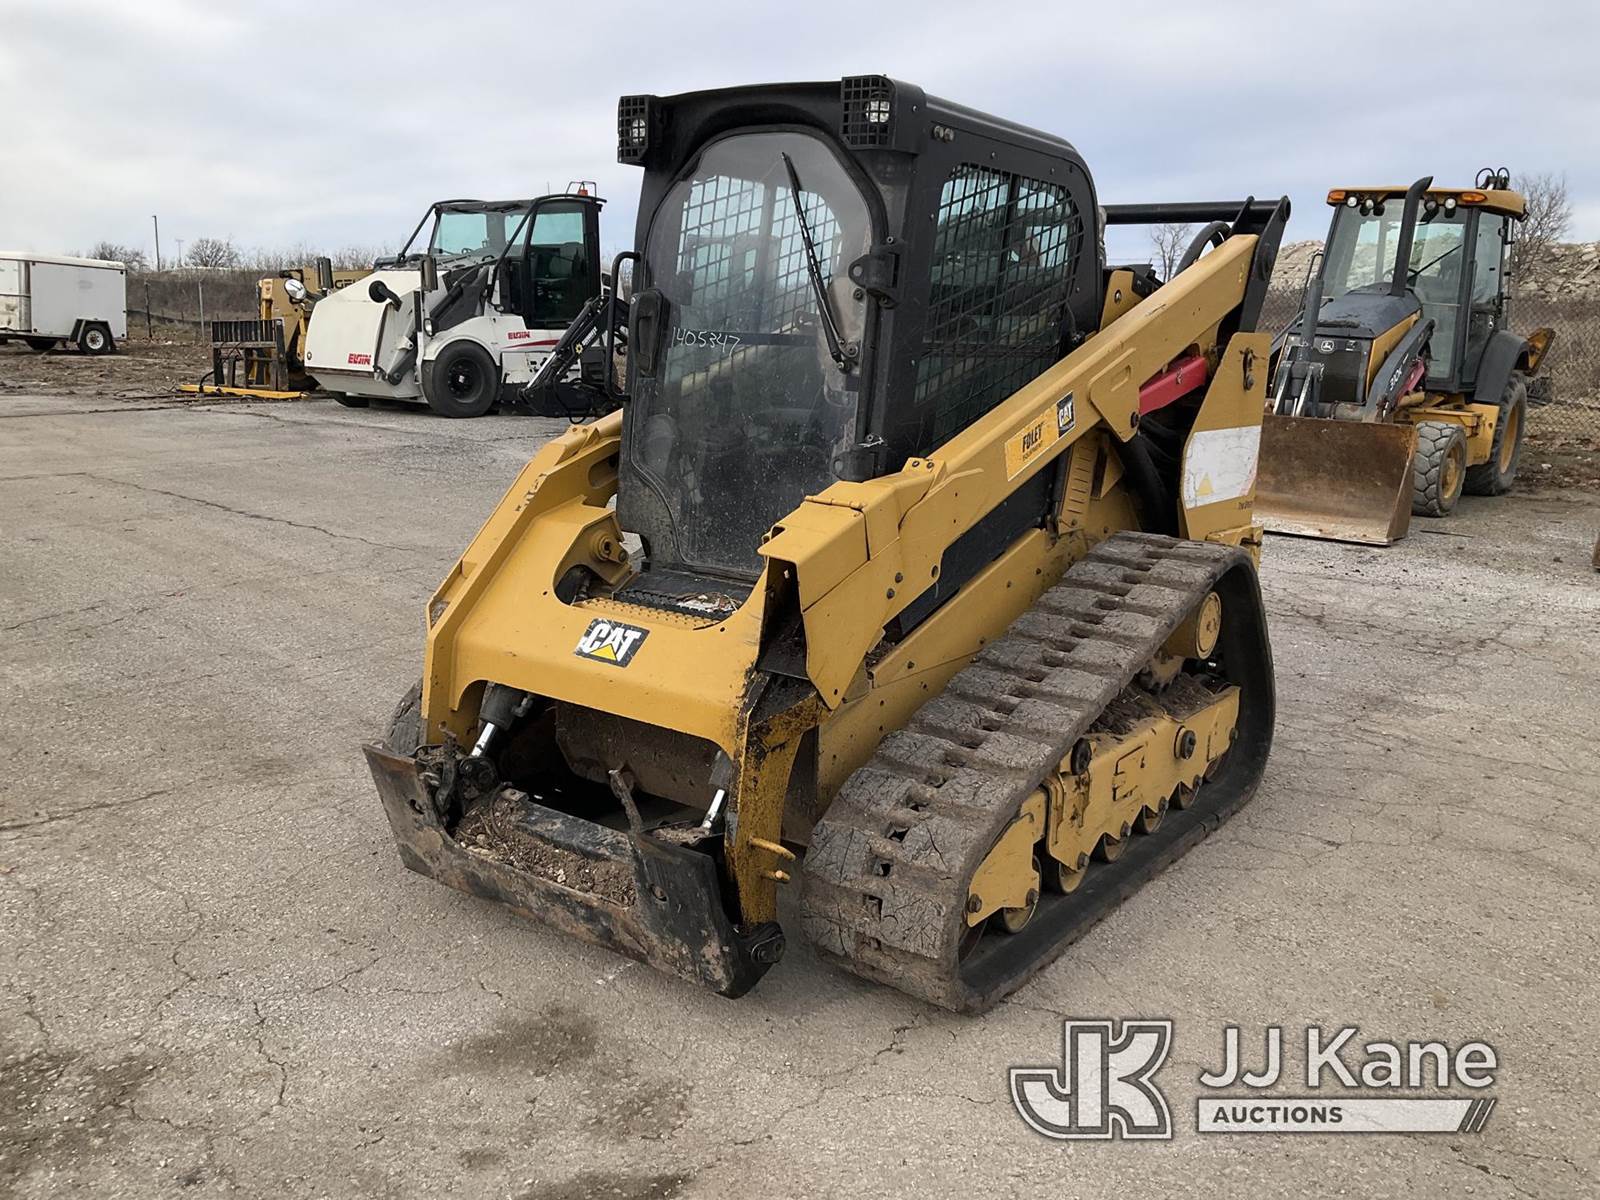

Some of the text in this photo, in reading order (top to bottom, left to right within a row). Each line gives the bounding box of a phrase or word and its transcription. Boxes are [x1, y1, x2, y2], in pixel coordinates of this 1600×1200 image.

[507, 331, 530, 340] ELGIN
[671, 326, 740, 357] 1405347
[348, 353, 371, 365] ELGIN
[1059, 401, 1072, 428] CAT
[581, 622, 643, 662] CAT
